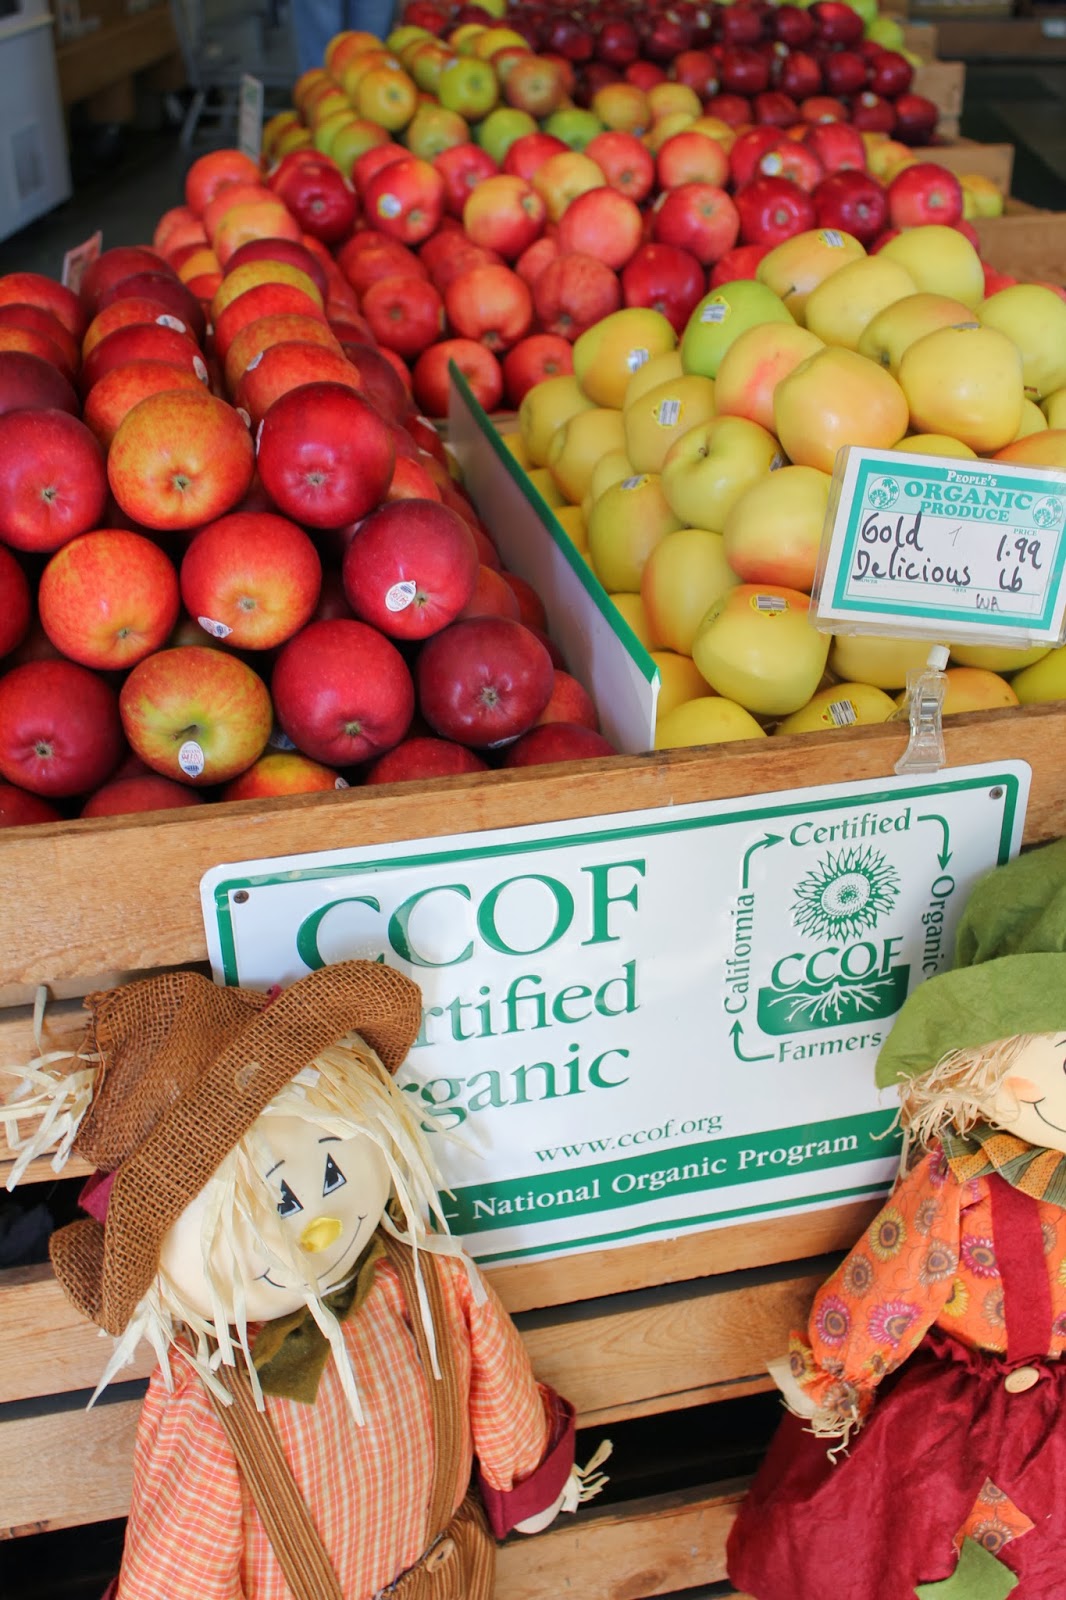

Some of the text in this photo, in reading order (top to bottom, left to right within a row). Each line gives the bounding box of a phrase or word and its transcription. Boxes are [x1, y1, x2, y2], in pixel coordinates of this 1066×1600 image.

[904, 481, 1033, 510] ORGANIC
[919, 500, 1010, 523] PRODUCE
[861, 511, 924, 551] Gold
[996, 534, 1042, 570] 1.99
[1013, 528, 1038, 537] PRICE
[852, 546, 971, 587] Delicious
[789, 807, 911, 847] Certified
[296, 858, 646, 972] CCOF
[922, 875, 955, 973] Organic
[723, 893, 755, 1014] California
[770, 936, 903, 990] CCOF
[412, 959, 641, 1049] rtified
[777, 1031, 882, 1063] Farmers
[400, 1043, 630, 1133] ganic
[535, 1115, 722, 1163] www.ccof.org
[472, 1179, 601, 1220] National
[611, 1156, 727, 1195] Organic
[737, 1134, 858, 1170] Program
